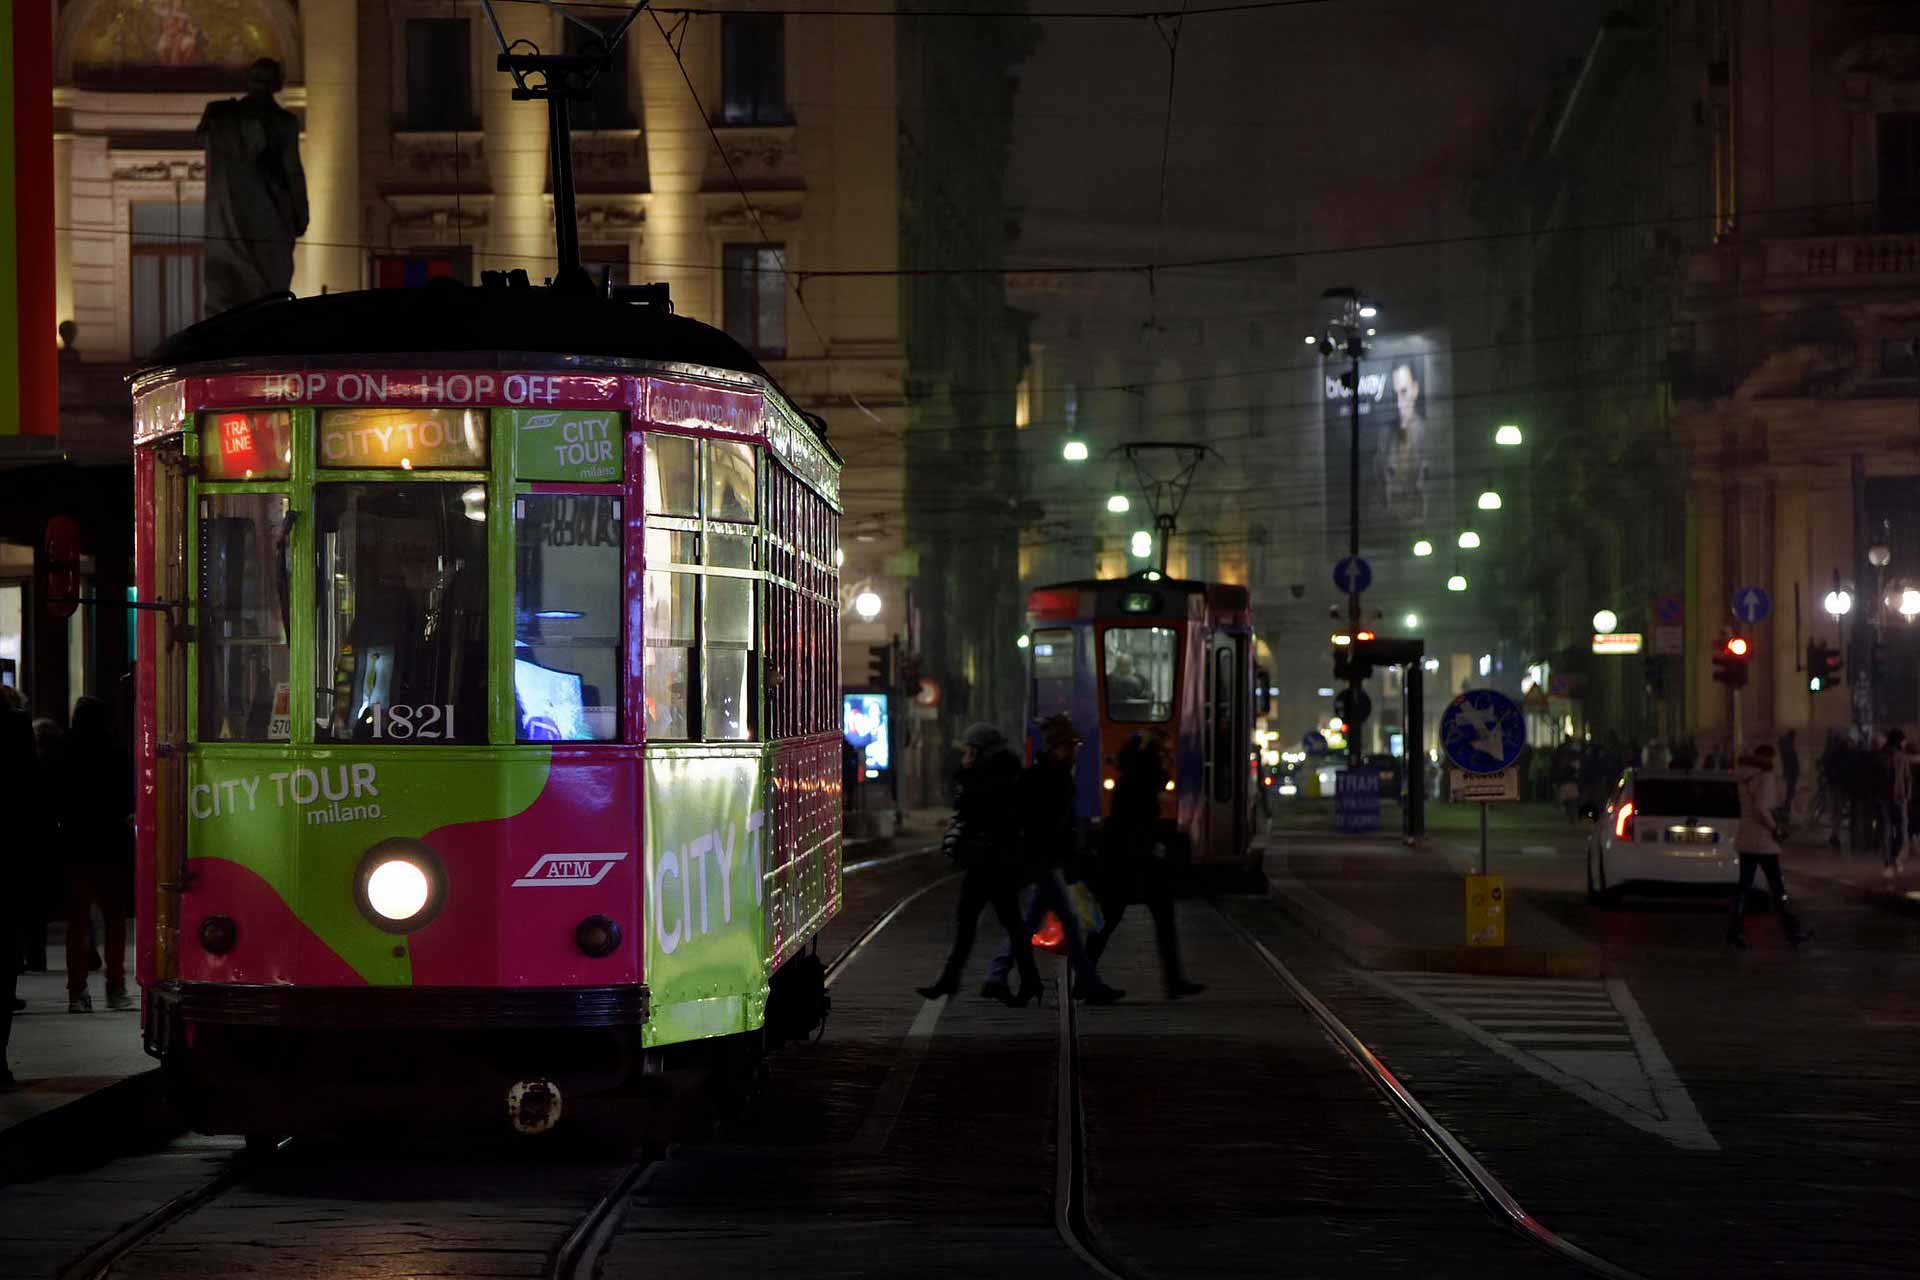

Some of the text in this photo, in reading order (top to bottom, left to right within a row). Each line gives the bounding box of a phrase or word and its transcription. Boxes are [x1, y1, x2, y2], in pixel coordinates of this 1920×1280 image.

[265, 373, 561, 404] HOP ON HOP OFF
[326, 426, 393, 460] CITY
[562, 418, 609, 443] CITY
[225, 436, 252, 454] LINE
[554, 440, 614, 466] TOUR
[580, 466, 615, 478] milano
[371, 703, 455, 739] 1821
[191, 763, 379, 820] CITY TOUR
[307, 802, 381, 825] milano
[546, 861, 592, 878] ATM
[655, 820, 736, 954] CITY
